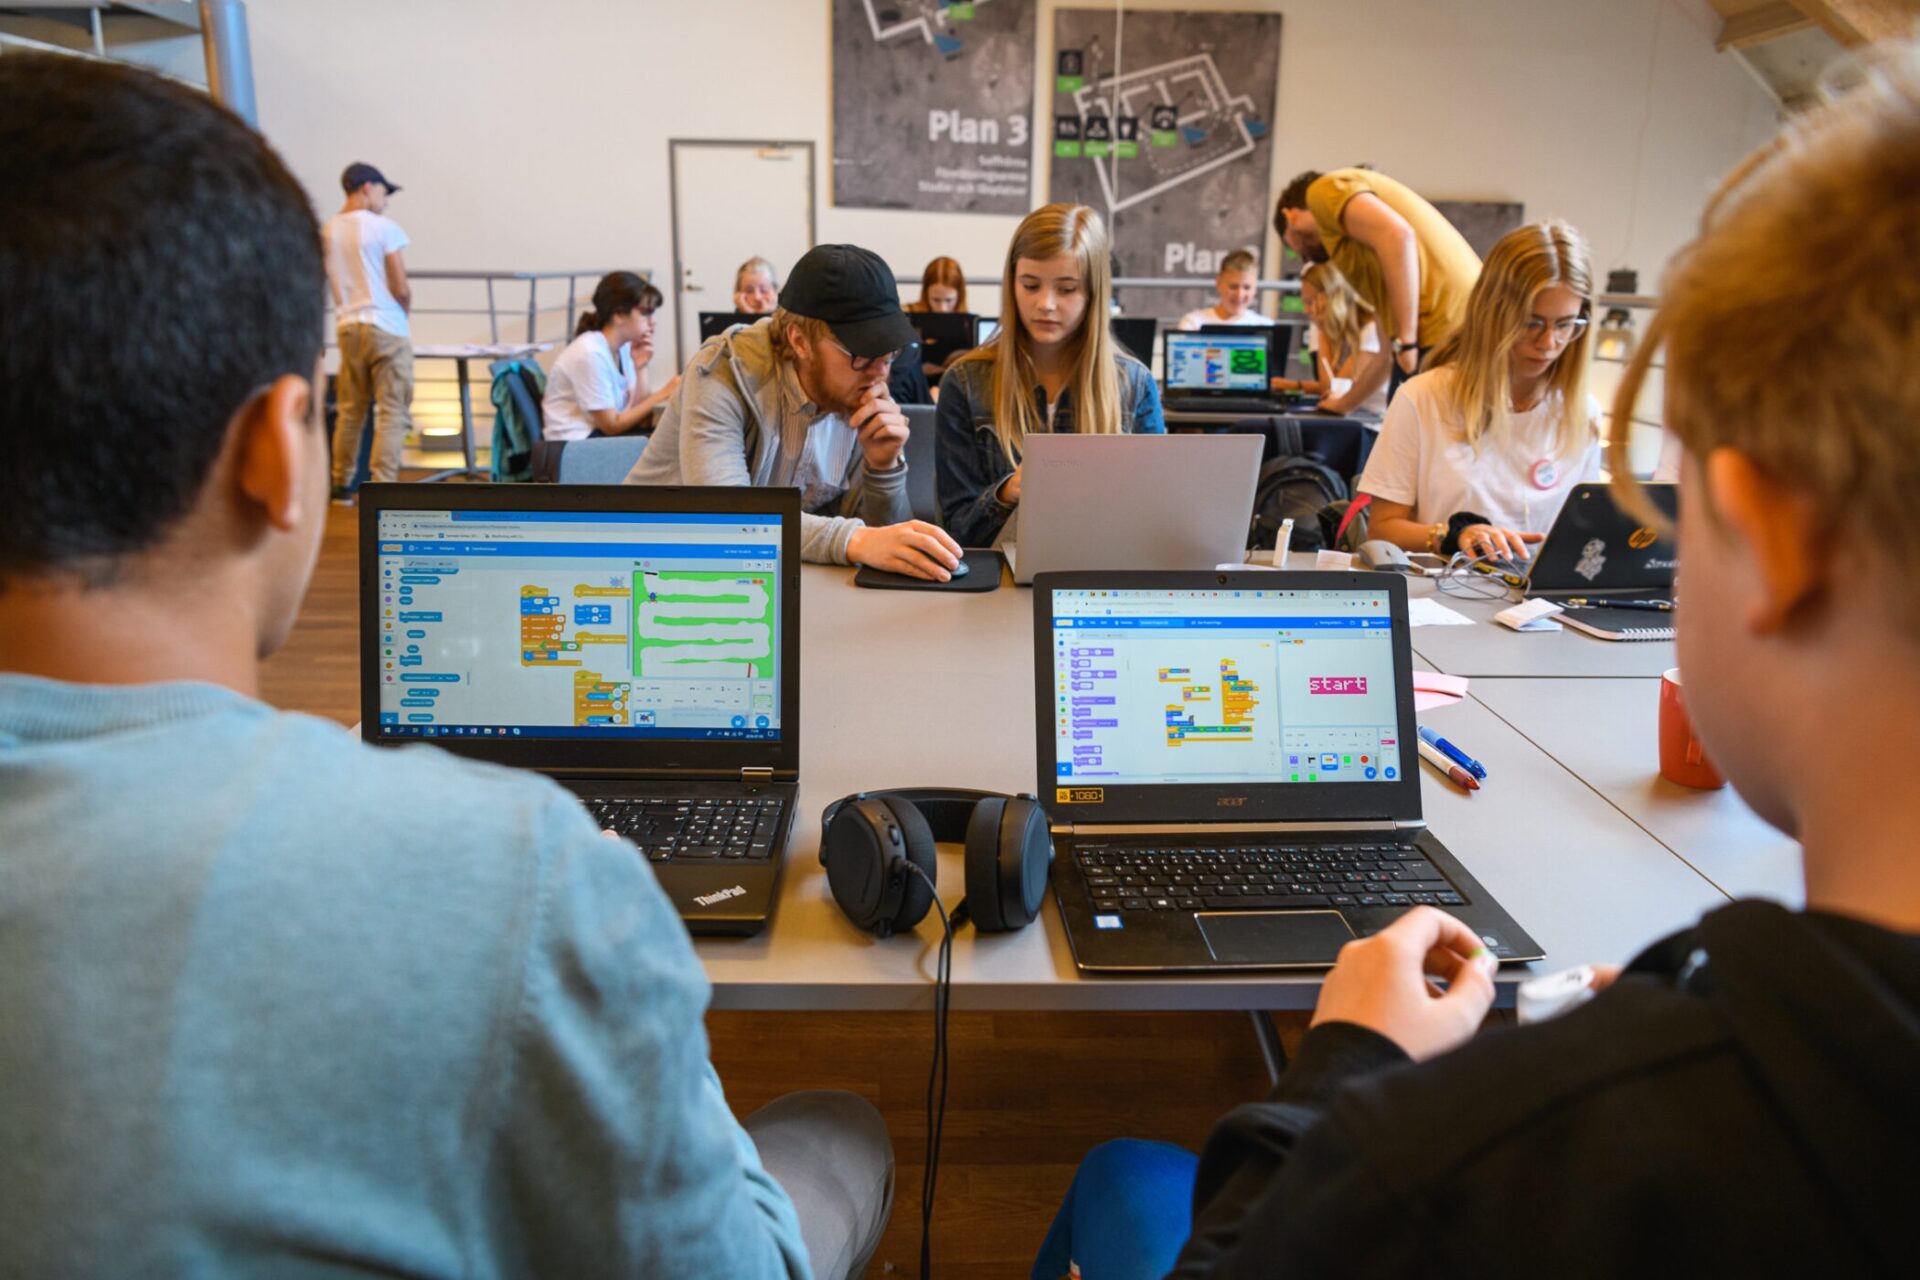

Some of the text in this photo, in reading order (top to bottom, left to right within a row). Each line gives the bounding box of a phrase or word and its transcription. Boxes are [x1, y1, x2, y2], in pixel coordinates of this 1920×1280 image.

[928, 109, 1028, 147] Plan 3
[1309, 677, 1366, 691] start
[1074, 791, 1098, 801] 1080
[693, 885, 747, 906] ThinkPad
